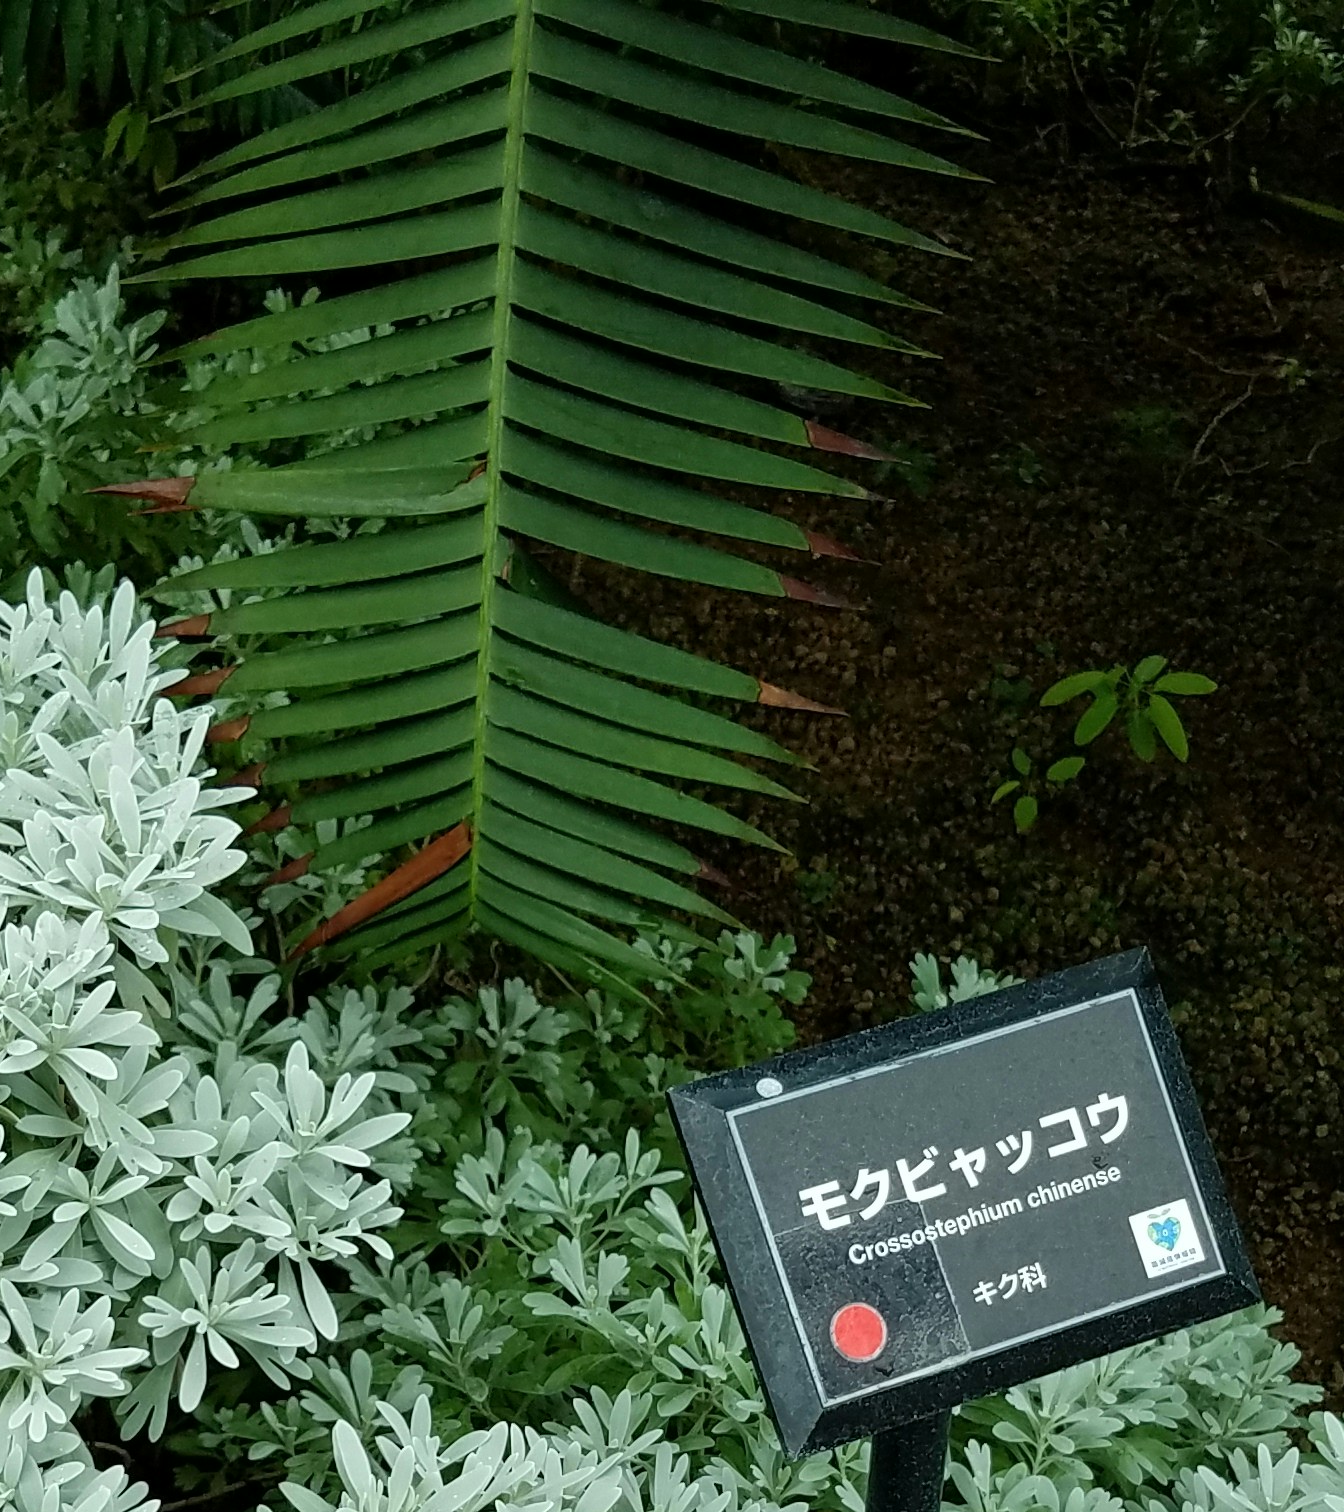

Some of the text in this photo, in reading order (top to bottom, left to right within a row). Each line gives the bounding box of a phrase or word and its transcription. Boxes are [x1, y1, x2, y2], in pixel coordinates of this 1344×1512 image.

[798, 1092, 1129, 1231] モクビャッコウ
[848, 1166, 1121, 1265] Crossostephium chinense
[972, 1262, 1048, 1306] キク科
